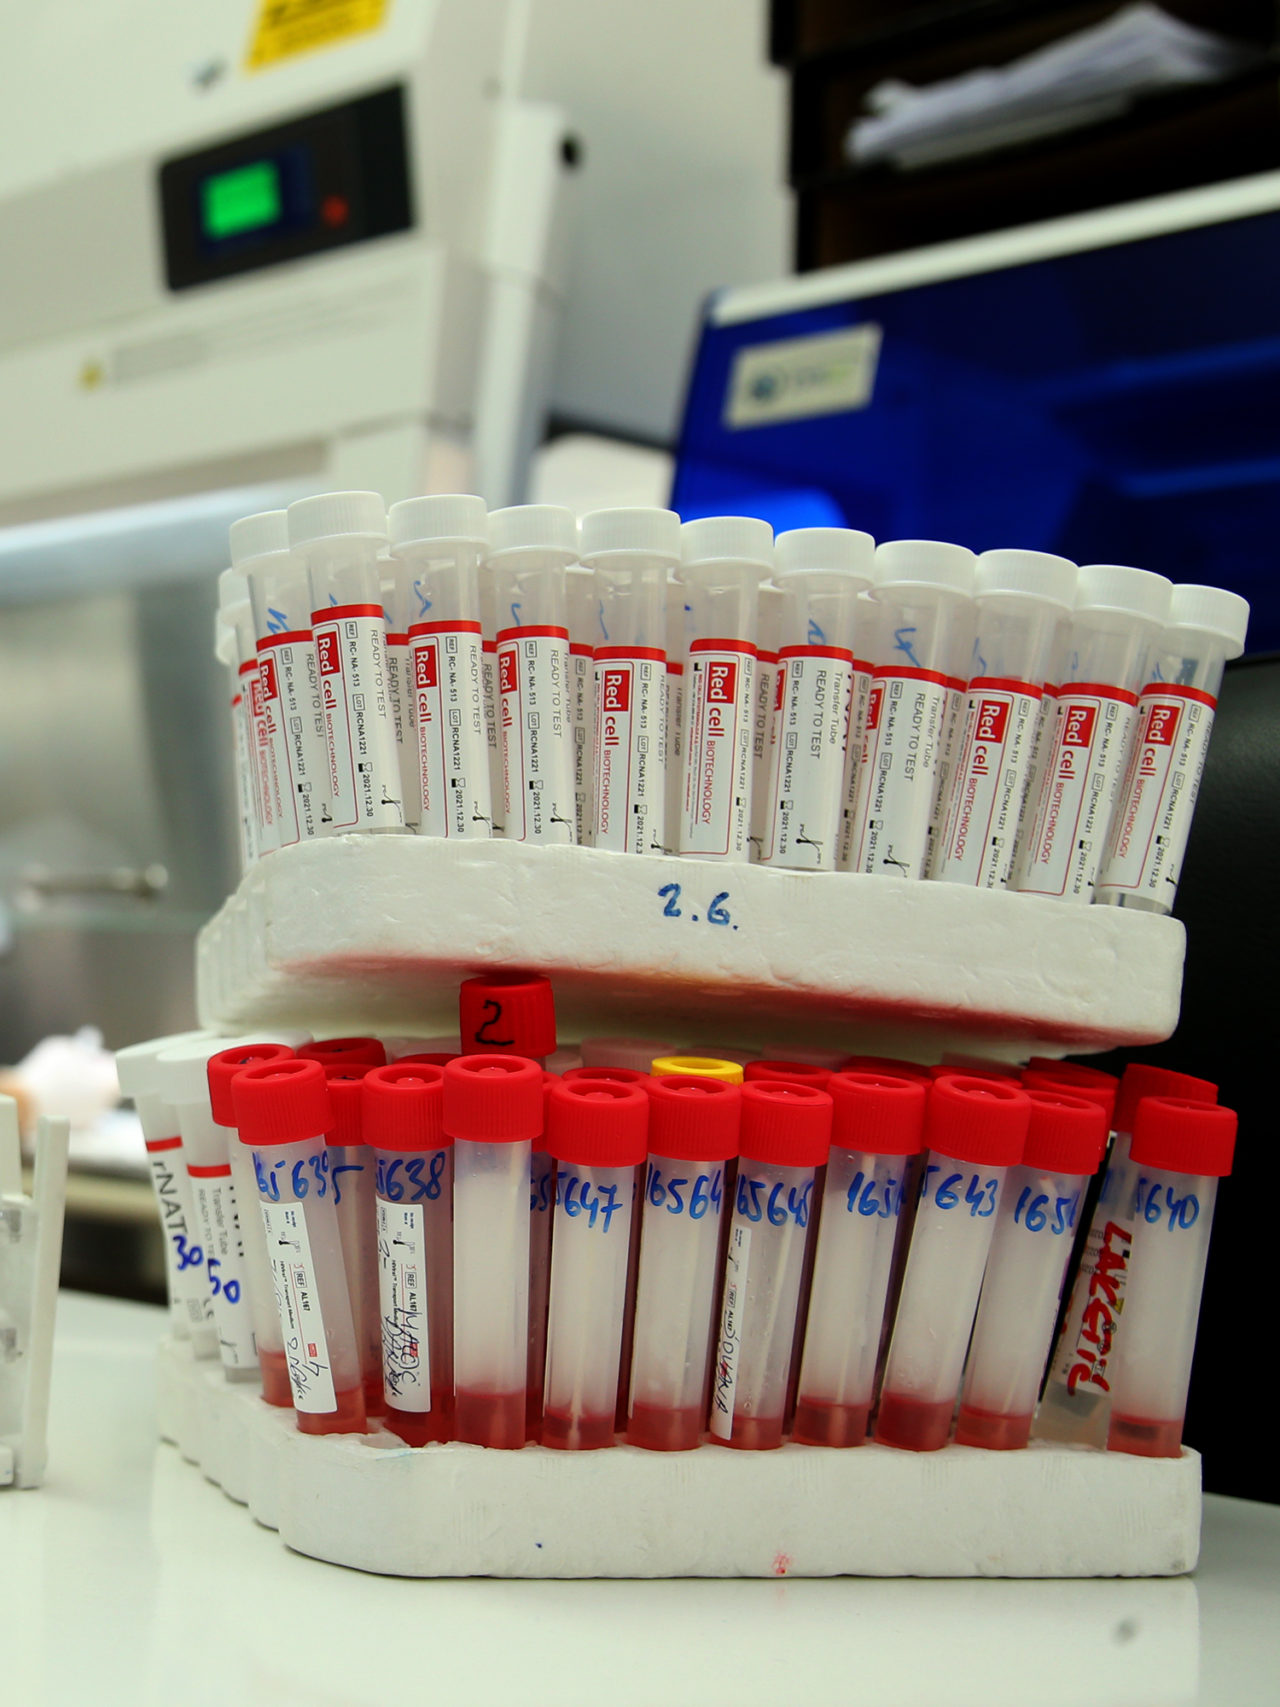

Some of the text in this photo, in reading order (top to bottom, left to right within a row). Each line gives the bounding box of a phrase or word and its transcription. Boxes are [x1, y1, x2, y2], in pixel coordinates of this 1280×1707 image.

[261, 665, 272, 698] Red
[306, 653, 318, 691] READY
[313, 692, 320, 708] TO
[371, 630, 385, 718] READY TO TEST
[472, 687, 479, 702] TO
[484, 663, 493, 701] READY
[500, 657, 511, 690] Red
[550, 650, 561, 738] READY TO TEST
[265, 706, 276, 734] cell
[320, 638, 339, 797] Red cell BIOTECHNOLOGY
[473, 704, 481, 734] TEST
[501, 698, 512, 727] cell
[754, 673, 769, 758] READY TO TEST
[811, 670, 826, 759] READY TO TEST
[829, 673, 842, 745] Transfer Tube
[979, 705, 1000, 739] Red
[1066, 710, 1087, 743] Red
[1148, 710, 1170, 741] Red
[356, 712, 367, 755] RCNA1221
[417, 651, 431, 811] Red cell BIOTECHNOLOGY
[452, 727, 461, 770] RCNA1221
[488, 719, 496, 748] TEST
[702, 667, 728, 824] Red cell BIOTECHNOLOGY
[904, 692, 925, 782] READY TO TEST
[923, 697, 939, 768] Transfer Tube
[295, 734, 305, 776] RCNA1221
[601, 675, 622, 834] Red cell BIOTECHNOLOGY
[638, 754, 646, 797] RCNA1221
[739, 746, 747, 790] RCNA1221
[785, 751, 793, 793] RCNA1221
[972, 745, 989, 775] cell
[1059, 751, 1075, 780] cell
[1140, 748, 1156, 776] cell
[875, 770, 887, 813] RCNA1221
[1085, 791, 1099, 834] RCNA1221
[1163, 789, 1178, 830] RCNA1221
[955, 778, 978, 861] BIOTECHNOLOGY
[1041, 783, 1064, 864] BIOTECHNOLOGY
[1119, 779, 1145, 858] BIOTECHNOLOGY
[657, 883, 738, 930] 2.6.
[475, 999, 515, 1047] 2
[173, 1235, 204, 1271] 30
[219, 1230, 227, 1255] Tube
[295, 1272, 310, 1312] REF AL167
[407, 1273, 417, 1312] REF AL167
